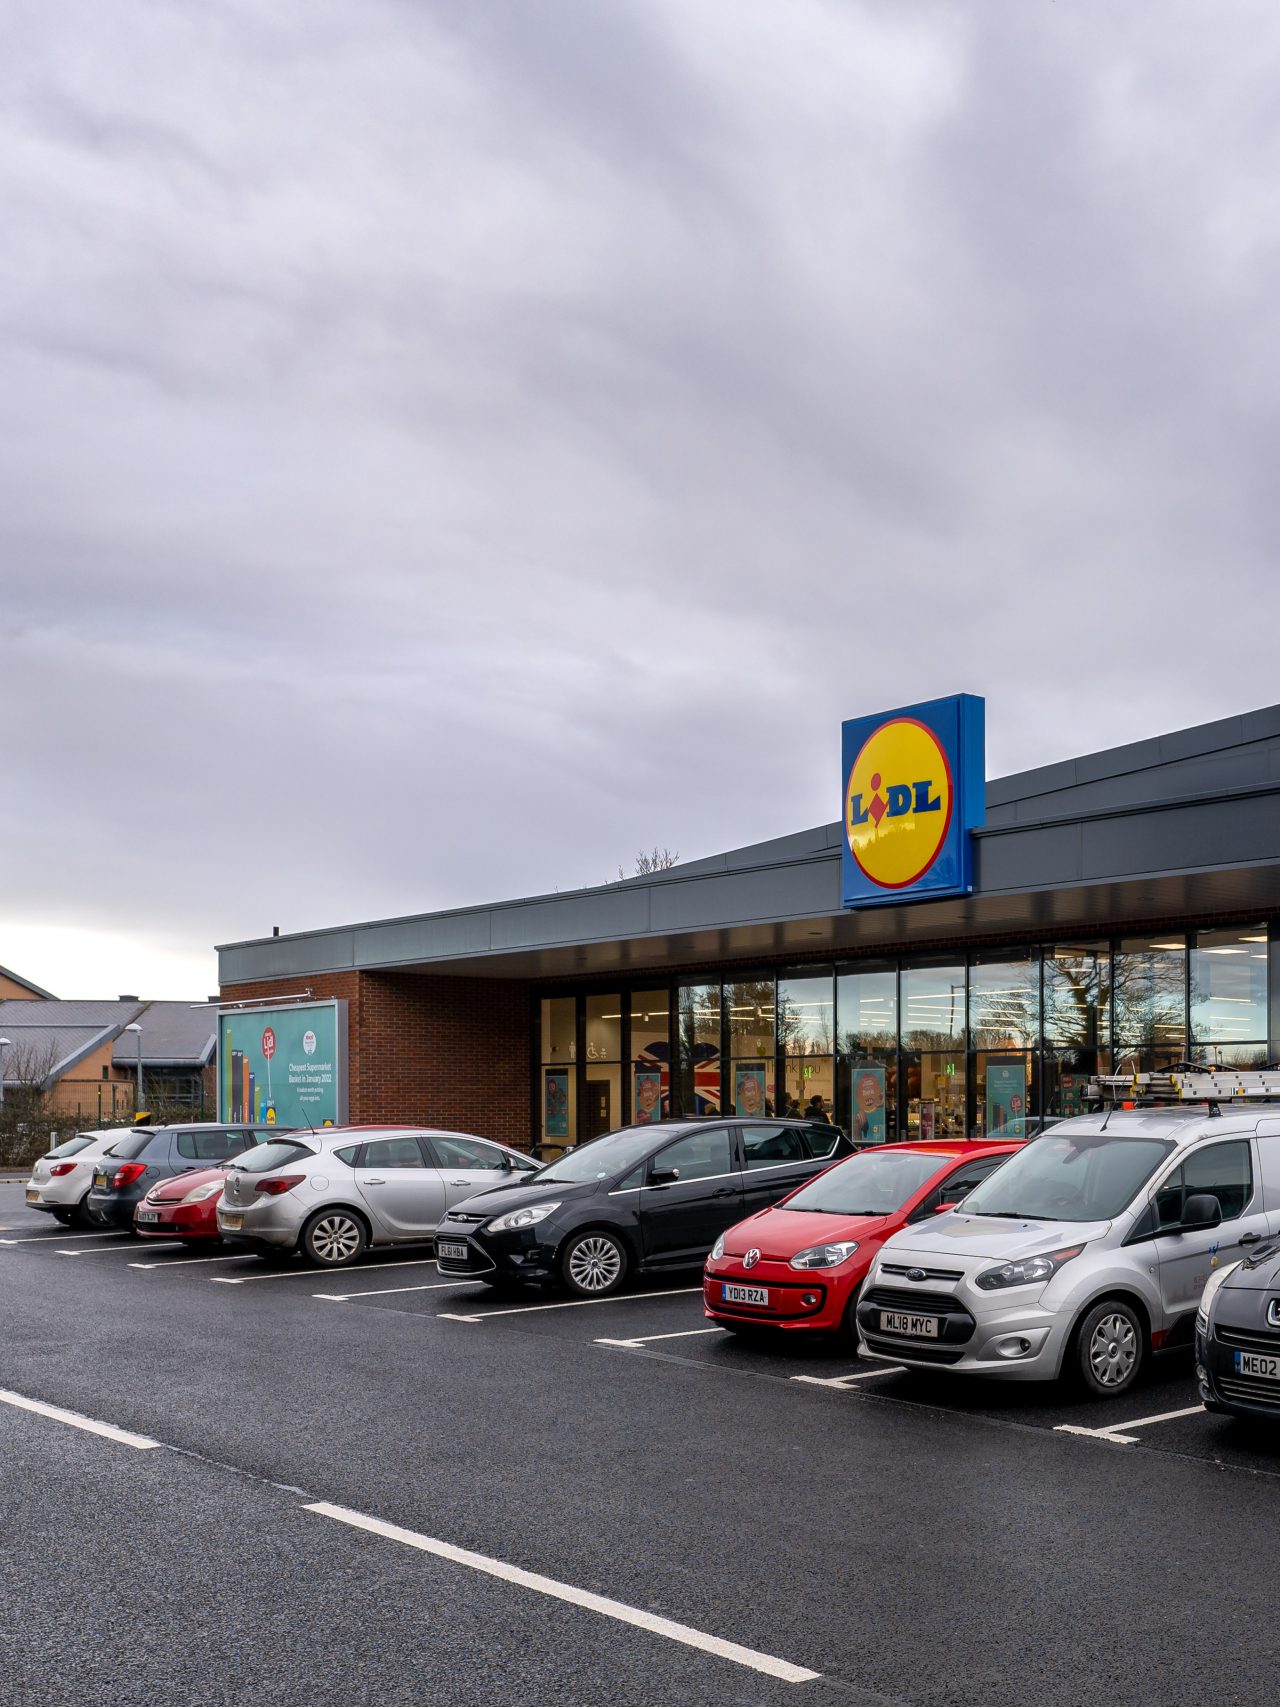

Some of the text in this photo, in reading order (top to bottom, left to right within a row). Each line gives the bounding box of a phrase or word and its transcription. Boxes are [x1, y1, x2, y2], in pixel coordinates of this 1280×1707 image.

[288, 1062, 332, 1074] Cheapest Supermarket
[288, 1074, 302, 1083] Basket
[306, 1074, 321, 1084] January
[728, 1286, 765, 1303] YD13 RZA
[886, 1314, 932, 1333] ML18 MYC
[1242, 1355, 1277, 1377] ME02
